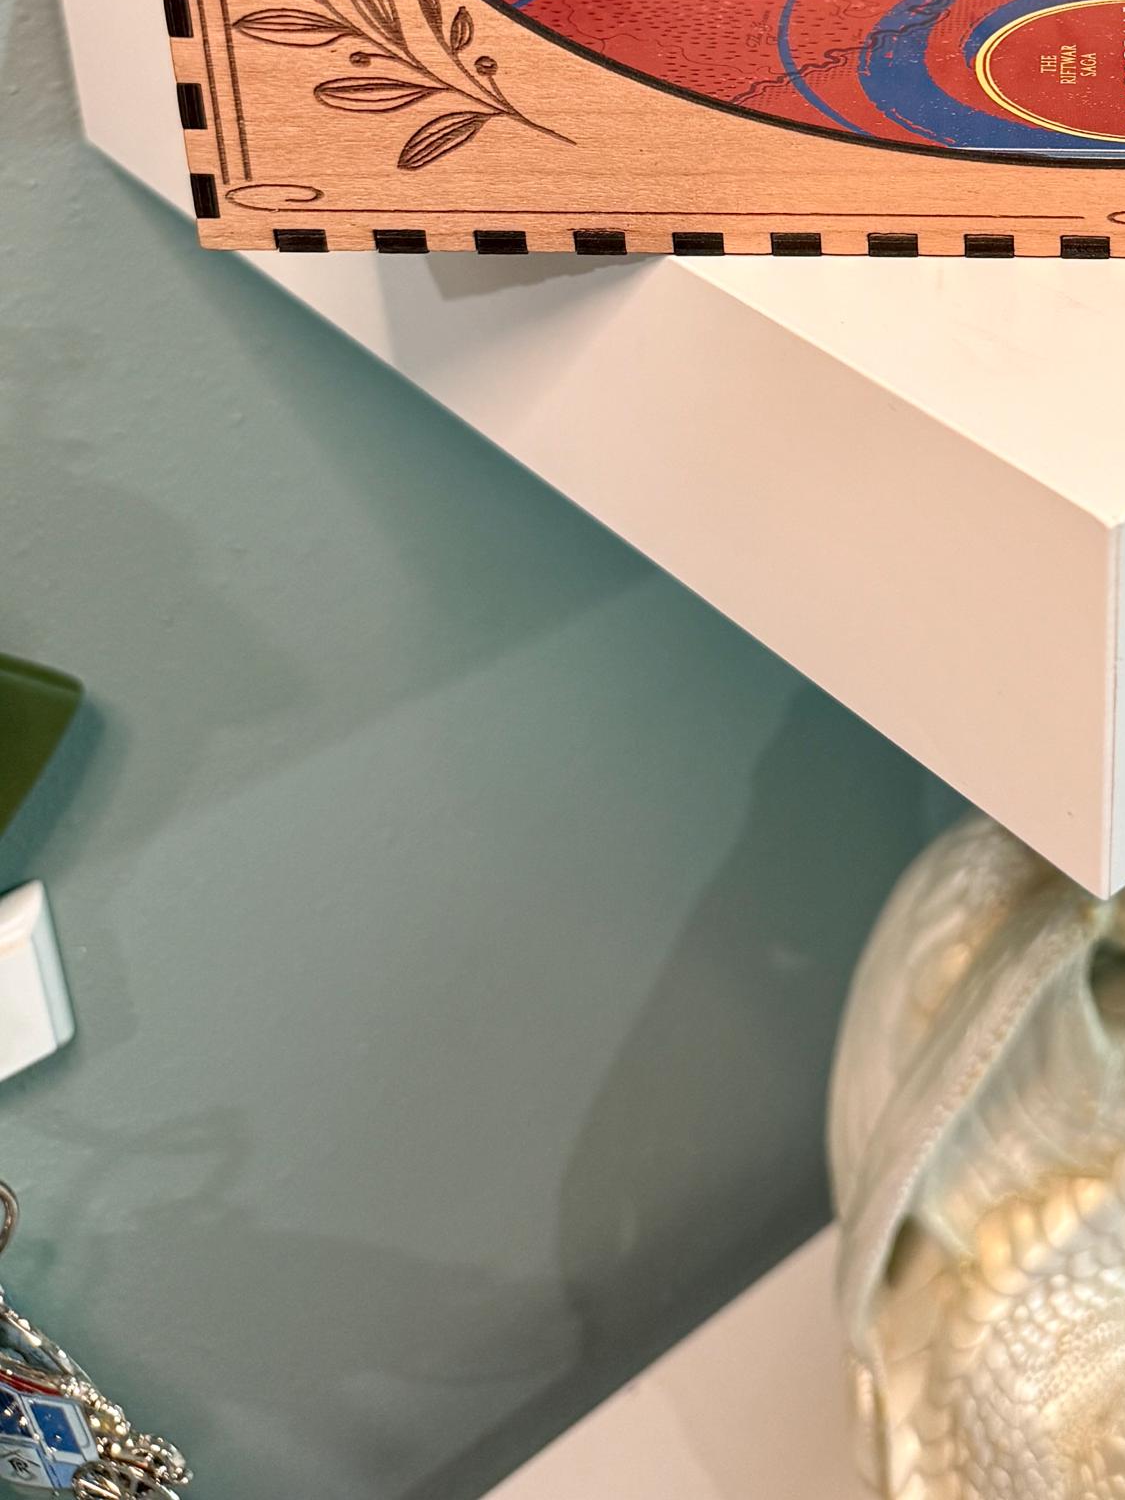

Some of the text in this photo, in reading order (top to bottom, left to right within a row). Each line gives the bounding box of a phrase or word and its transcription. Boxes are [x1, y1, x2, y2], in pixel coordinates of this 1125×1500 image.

[1041, 54, 1057, 75] THE
[1060, 44, 1076, 85] RIFTWAR
[1081, 52, 1097, 77] SAGA
